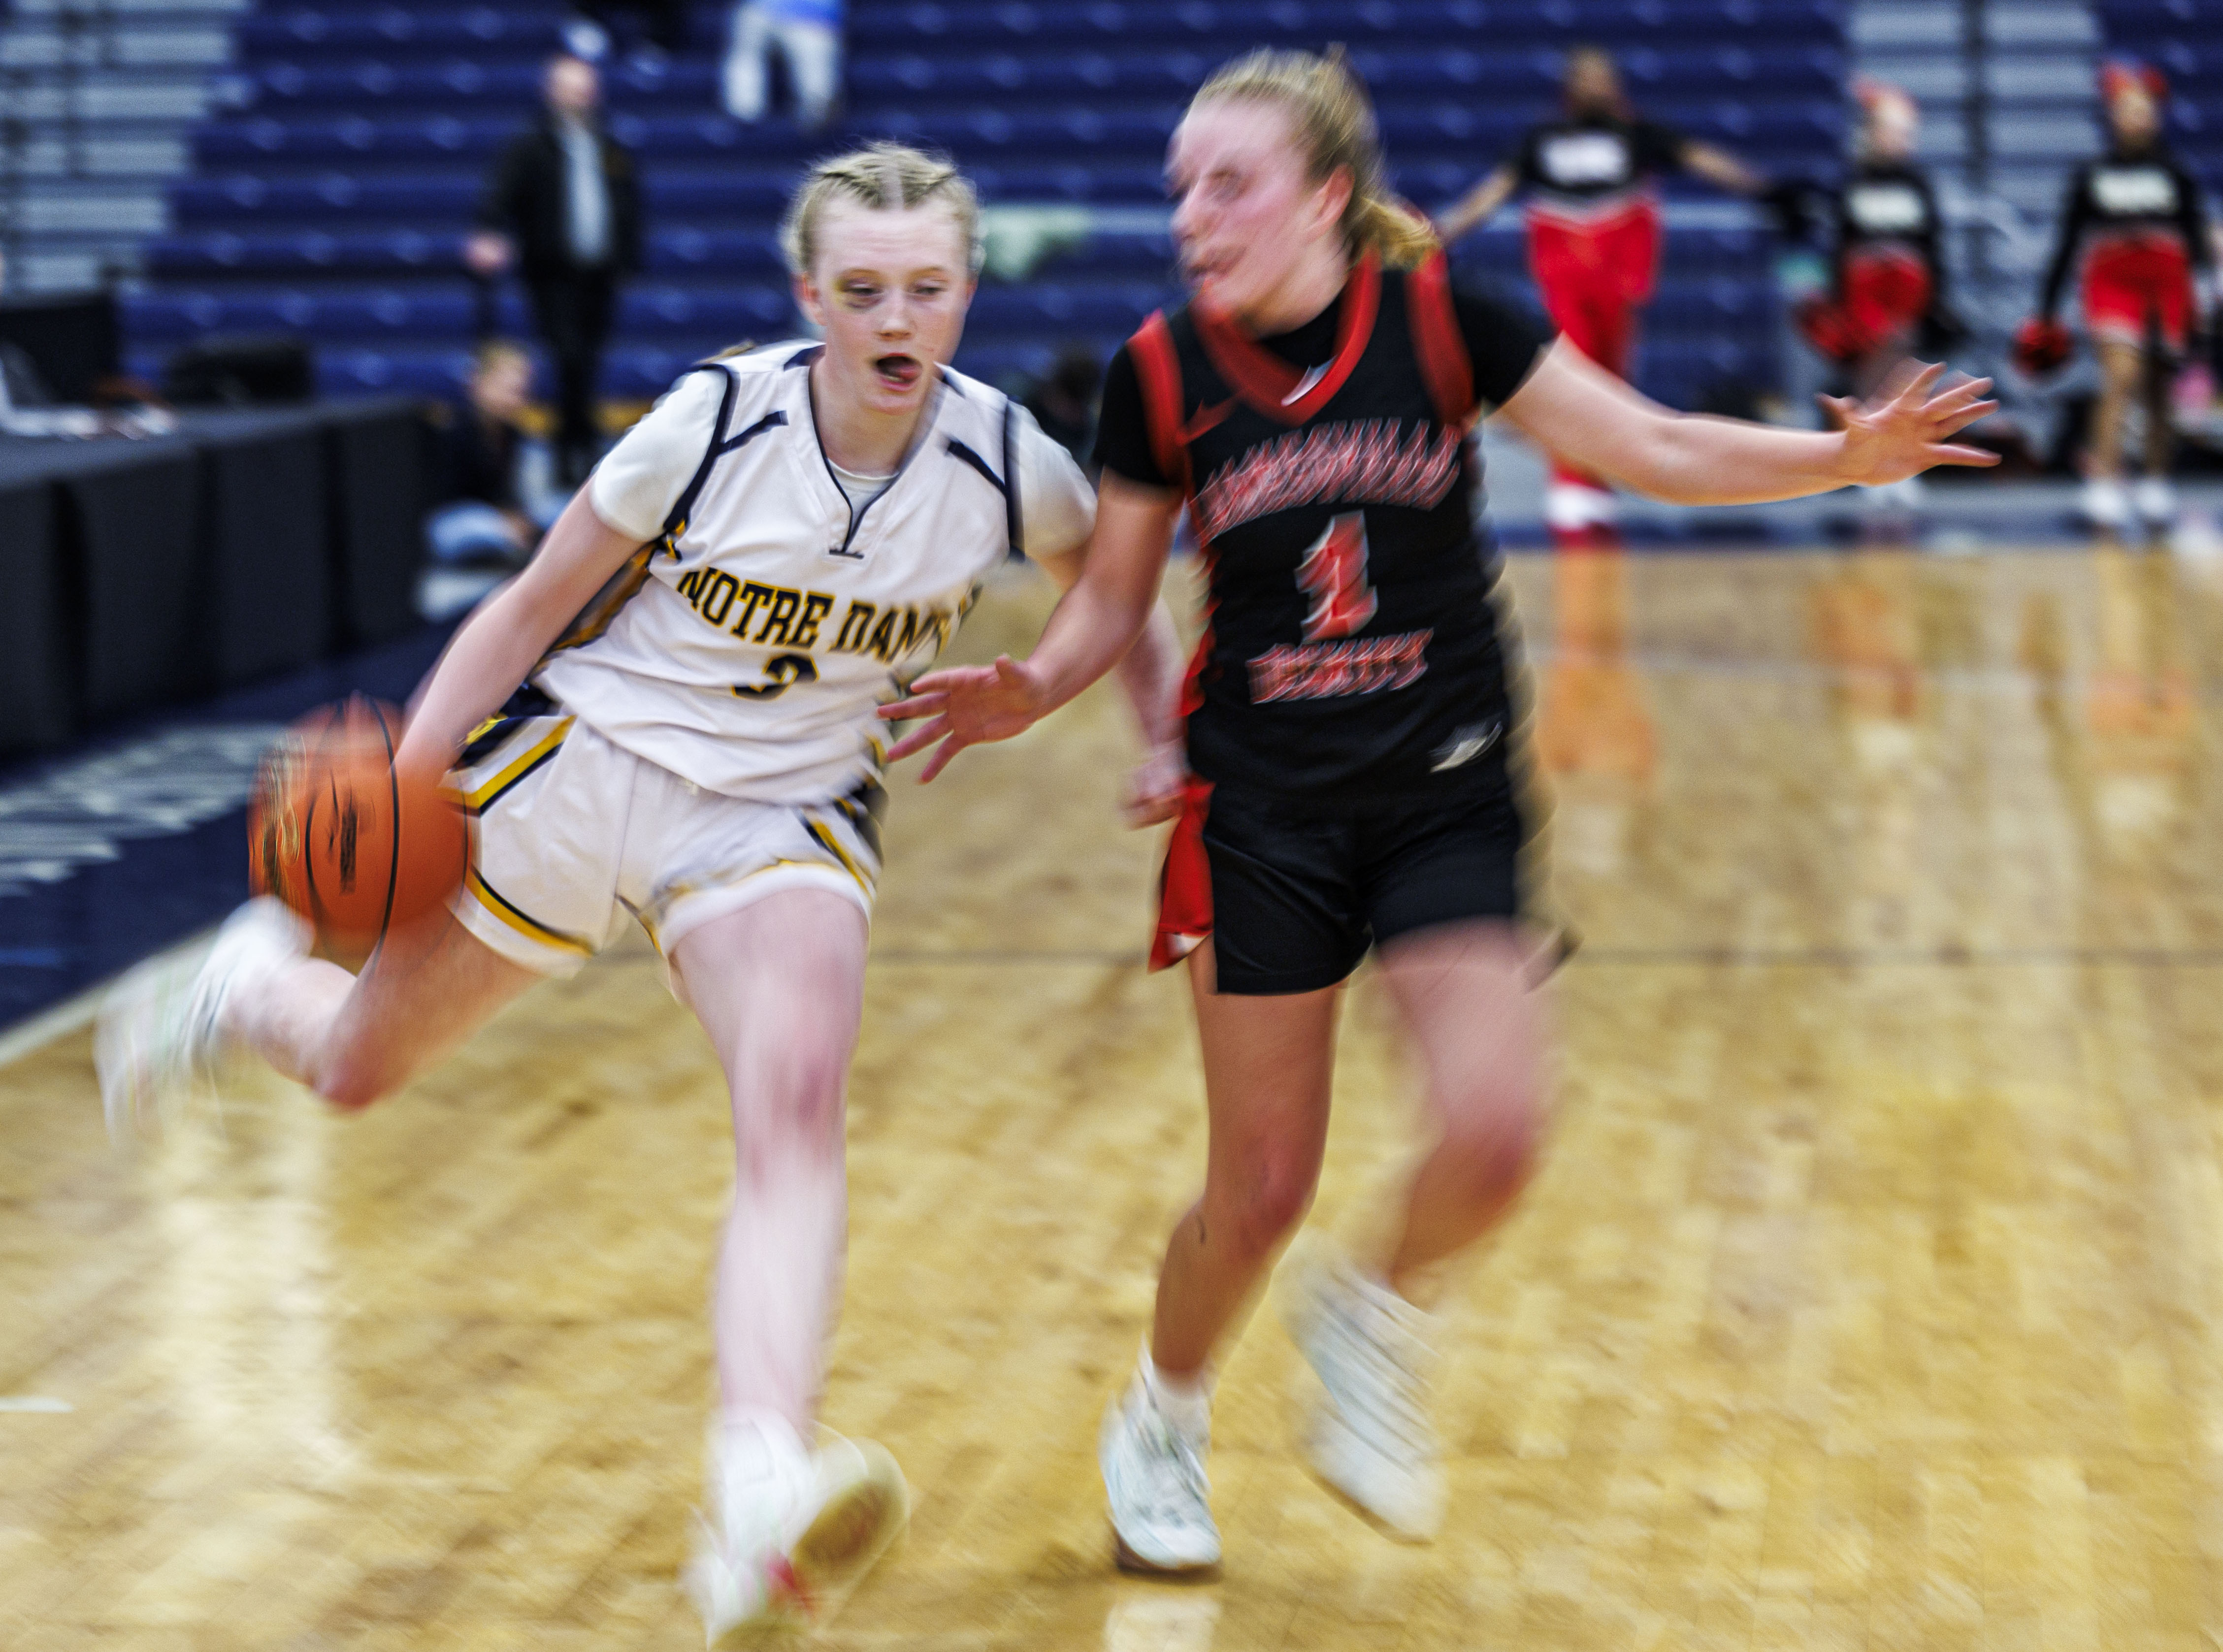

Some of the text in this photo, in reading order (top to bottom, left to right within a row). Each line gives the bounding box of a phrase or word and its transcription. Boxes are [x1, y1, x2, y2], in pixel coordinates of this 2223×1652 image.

[677, 566, 979, 664] NOTRE DAM
[1295, 510, 1378, 642] 1
